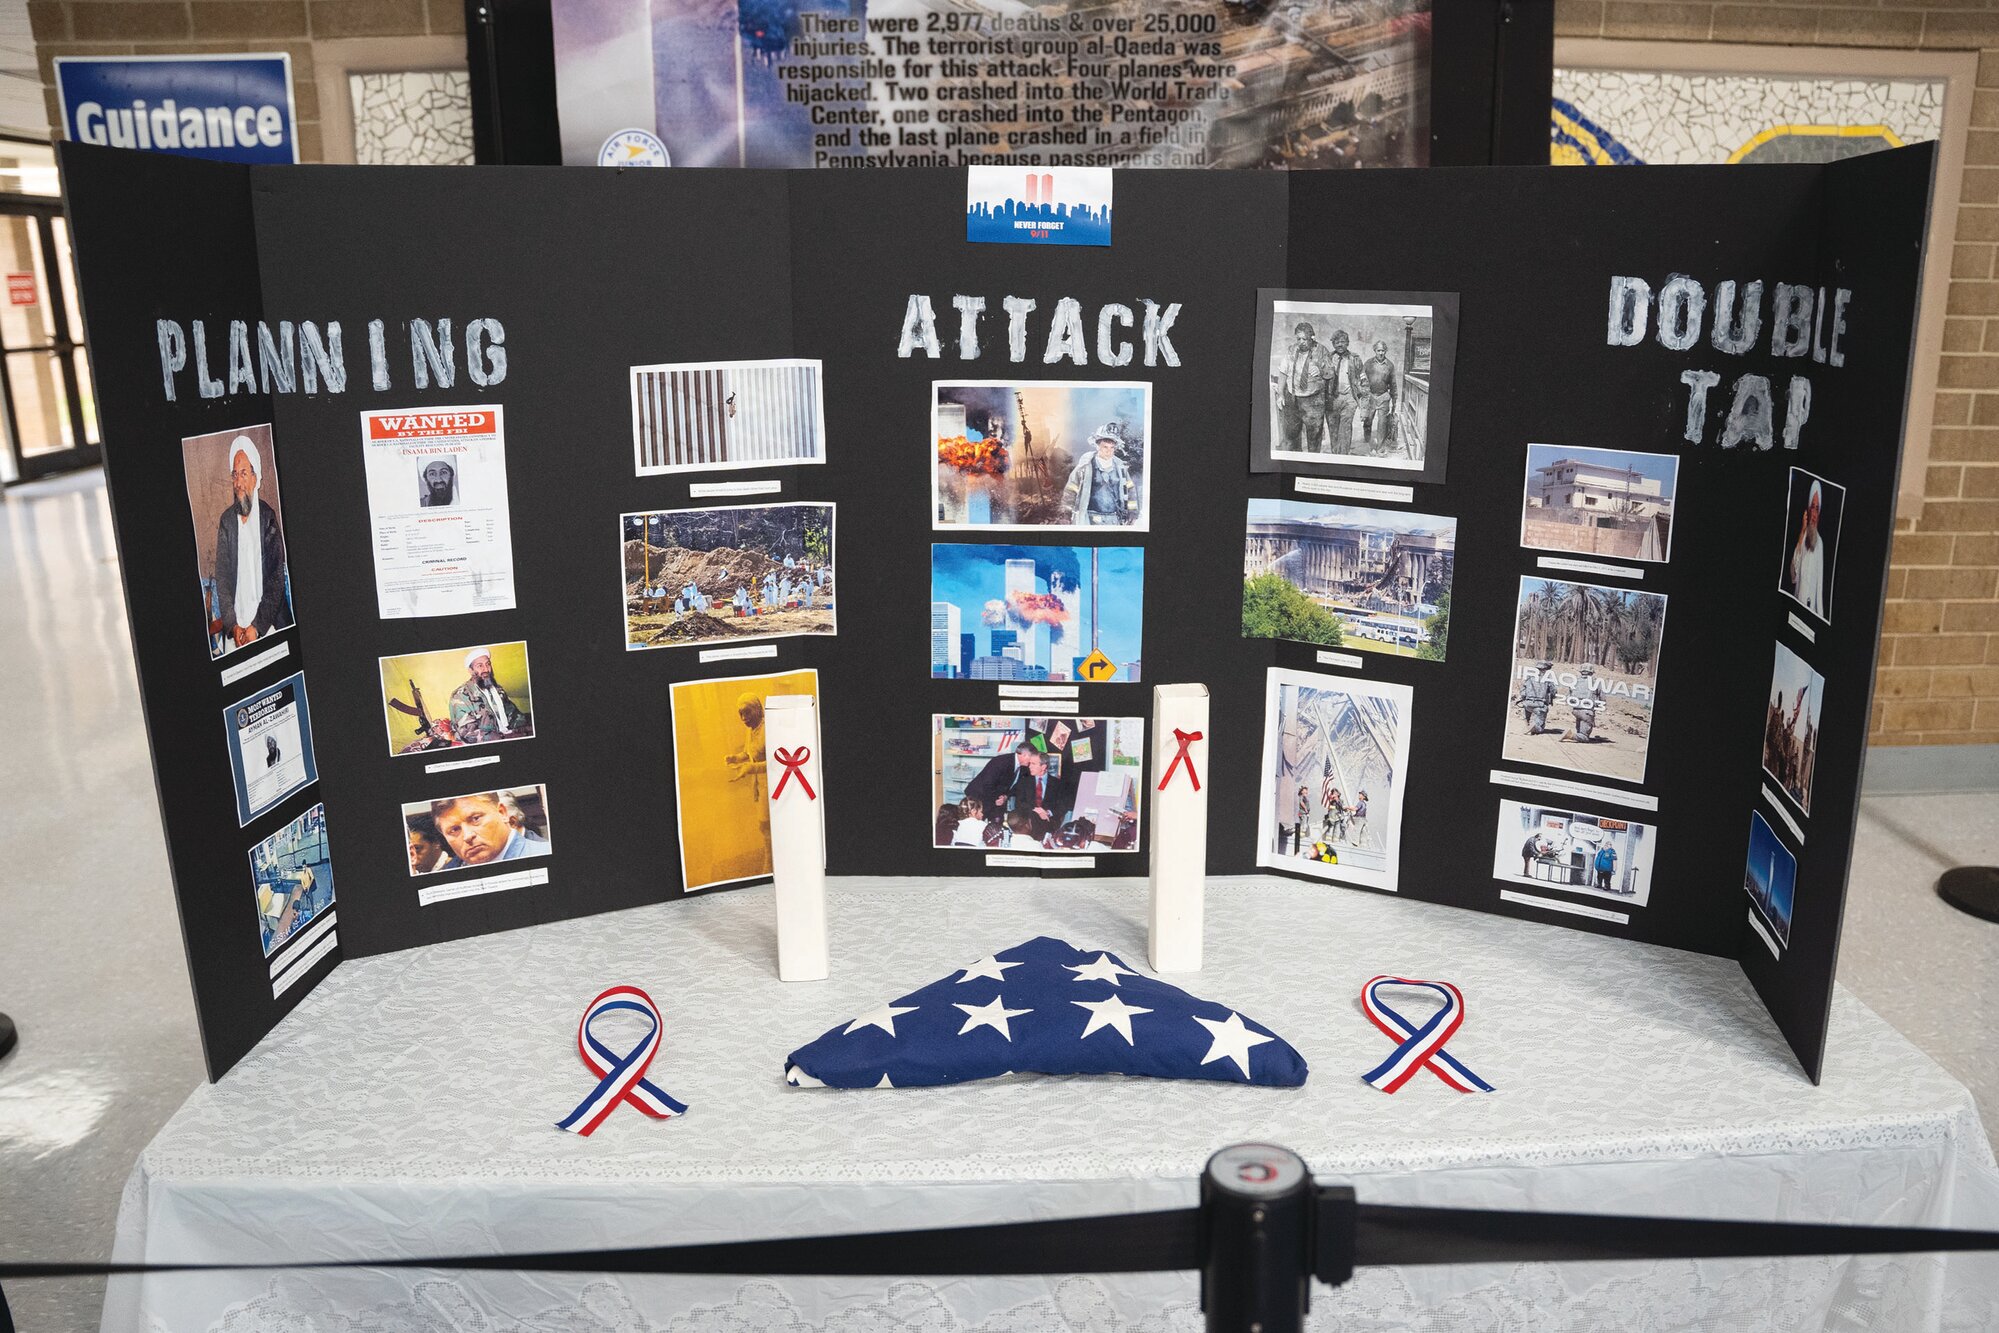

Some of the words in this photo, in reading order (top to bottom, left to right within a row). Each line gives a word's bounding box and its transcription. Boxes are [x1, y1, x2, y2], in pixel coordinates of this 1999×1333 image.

[801, 14, 859, 32] There
[868, 17, 919, 32] were
[927, 12, 983, 34] 2,977
[991, 12, 1060, 32] deaths
[1069, 13, 1084, 32] &
[1092, 18, 1136, 32] over
[1144, 14, 1216, 35] 25,000
[793, 37, 876, 59] injuries.
[883, 36, 920, 55] The
[928, 37, 1013, 55] terrorist
[1022, 41, 1078, 58] group
[1087, 35, 1175, 56] al-Qaeda
[1183, 41, 1222, 56] was
[778, 59, 896, 82] responsible
[903, 59, 933, 78] for
[940, 60, 978, 78] this
[987, 58, 1059, 78] attack.
[1067, 59, 1110, 77] Four
[1119, 58, 1182, 84] planes
[1190, 64, 1237, 78] were
[787, 82, 878, 105] hijacked.
[885, 82, 929, 100] Two
[936, 81, 1018, 100] crashed
[1026, 82, 1063, 100] into
[1072, 82, 1103, 100] the
[1111, 81, 1167, 100] World
[1174, 82, 1229, 100] Trade
[76, 99, 283, 149] Guidance
[811, 105, 885, 126] Center,
[892, 109, 929, 123] one
[937, 104, 1018, 123] crashed
[1026, 104, 1063, 123] into
[1072, 104, 1103, 123] the
[1111, 104, 1208, 126] Pentagon,
[627, 135, 660, 156] FORCE
[815, 129, 850, 147] and
[858, 129, 891, 146] the
[899, 128, 938, 146] last
[945, 127, 999, 149] plane
[1008, 127, 1087, 145] crashed
[1095, 127, 1112, 145] in
[1120, 131, 1131, 145] a
[1140, 127, 1180, 145] field
[1188, 128, 1206, 145] in
[815, 150, 949, 168] Pennsylvania
[957, 149, 1041, 166] because
[1050, 150, 1163, 168] passengers
[1171, 150, 1206, 166] and
[1014, 221, 1036, 229] NEVER
[1038, 221, 1064, 230] FORGET
[1030, 230, 1049, 238] 9/11
[897, 294, 1183, 367] ATTACK
[1607, 273, 1852, 367] DOUBLE
[157, 318, 508, 401] PLANNING
[379, 412, 485, 430] WANTED
[1680, 369, 1812, 451] TAP
[402, 447, 429, 456] USAMA
[443, 446, 468, 454] LADEN
[1516, 665, 1577, 690] IRAQ
[1587, 676, 1651, 700] WAR
[248, 701, 262, 714] MOST
[261, 691, 283, 706] WANTED
[249, 703, 277, 722] TERRORIST
[1555, 693, 1607, 712] 2003
